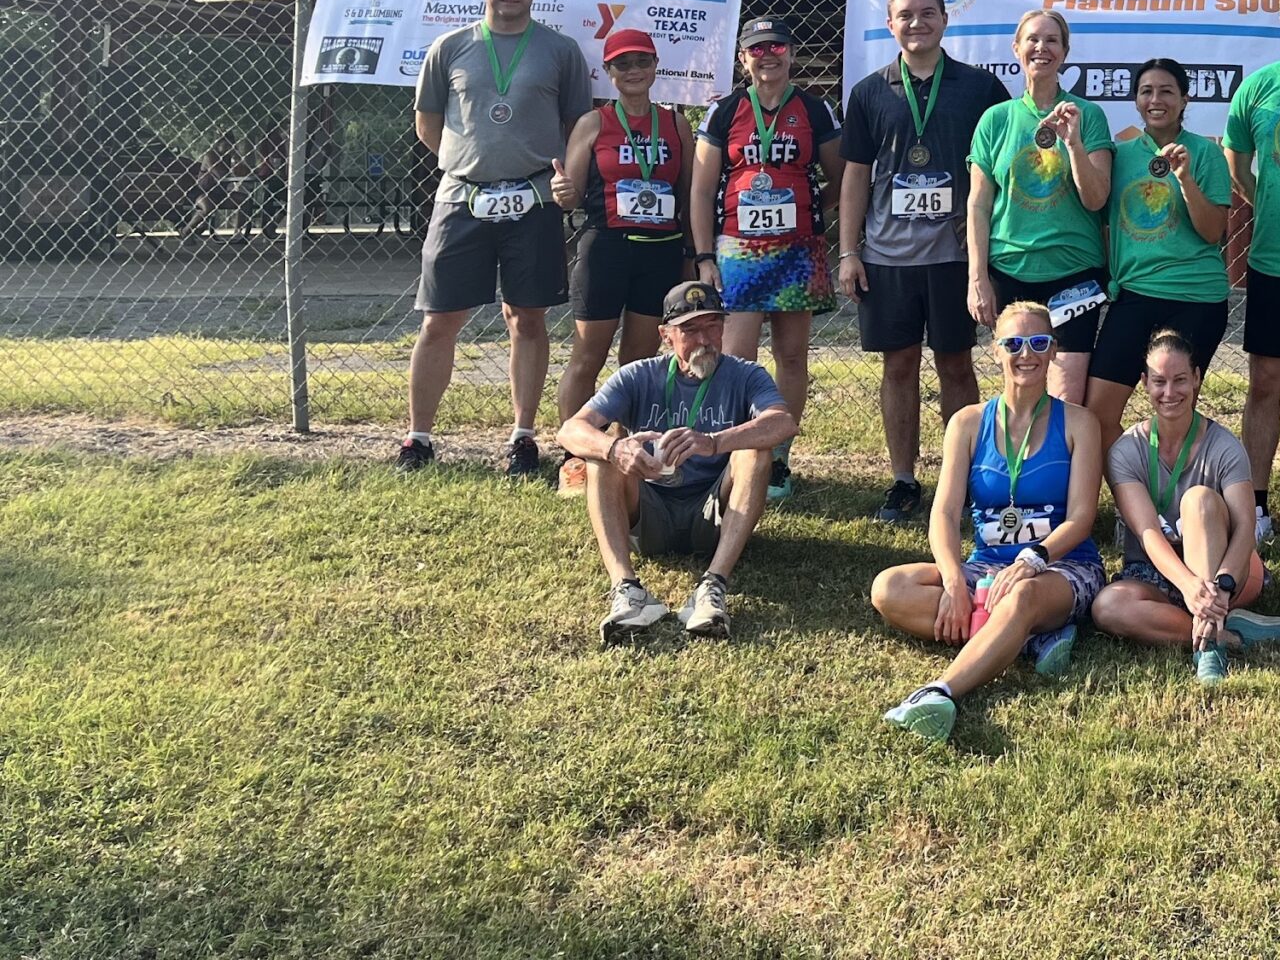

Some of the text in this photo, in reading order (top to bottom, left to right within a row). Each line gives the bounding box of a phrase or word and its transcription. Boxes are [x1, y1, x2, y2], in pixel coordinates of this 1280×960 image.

[344, 9, 350, 18] S
[358, 10, 363, 18] D
[364, 9, 404, 18] PLUMBING
[424, 1, 487, 15] Maxwell
[532, 0, 565, 13] nnie
[647, 6, 707, 21] GREATER
[582, 19, 597, 28] the
[654, 19, 697, 33] TEXAS
[681, 34, 705, 42] UNION
[655, 68, 689, 78] ational
[690, 70, 715, 81] Bank
[976, 62, 1021, 75] UTTO
[1085, 68, 1132, 97] BIG
[486, 194, 525, 216] 238
[904, 192, 942, 213] 246
[748, 208, 786, 229] 251
